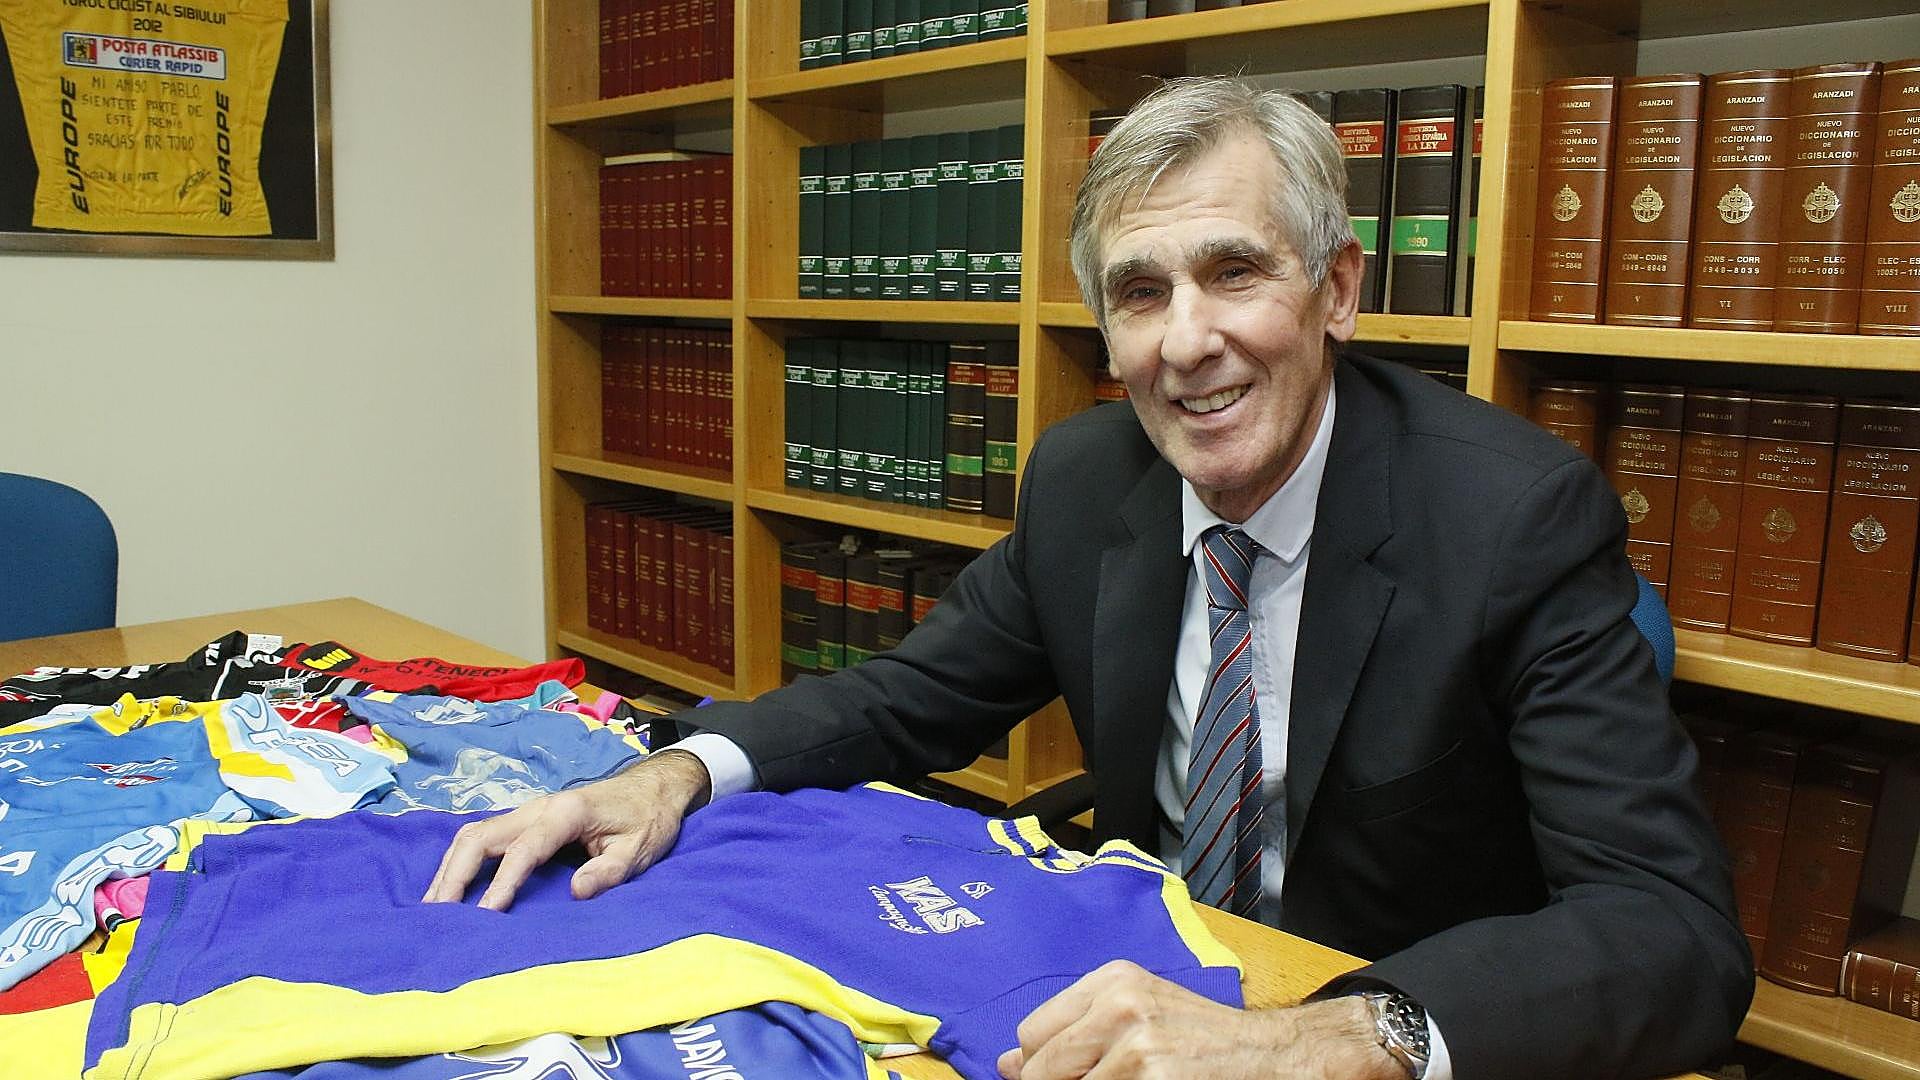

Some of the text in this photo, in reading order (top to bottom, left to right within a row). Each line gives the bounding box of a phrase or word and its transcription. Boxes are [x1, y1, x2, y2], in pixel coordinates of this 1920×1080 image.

[155, 3, 171, 16] AL
[174, 6, 226, 24] SIBIULUI
[133, 18, 162, 32] 2012
[102, 38, 219, 63] POSTA ATLASSIB
[119, 56, 203, 74] CURIER RAPID
[161, 81, 200, 99] PABLO
[1812, 90, 1854, 99] ARANZADI
[1639, 99, 1673, 108] ARANZADI
[1726, 96, 1765, 105] ARANZADI
[187, 104, 203, 117] DE
[106, 114, 132, 128] ESTE
[1817, 120, 1842, 128] NUEVO
[1714, 135, 1773, 144] DICCIONARIO
[1799, 131, 1861, 140] DICCIONARIO
[1551, 137, 1598, 145] ICCIONARIO
[1627, 136, 1681, 145] DICCIONARIO
[60, 76, 90, 215] EUROPE
[1354, 144, 1371, 152] LEY
[1407, 142, 1418, 150] LA
[216, 90, 233, 217] EUROPE
[1797, 151, 1859, 160] LEGISLACION
[1625, 155, 1680, 164] LEGISLACION
[1712, 155, 1771, 163] LEGISLACION
[1703, 255, 1725, 263] CONS
[1737, 256, 1760, 264] CORR
[1788, 256, 1810, 264] CORR
[1823, 256, 1846, 264] ELEC
[1877, 257, 1899, 265] ELEC
[1719, 300, 1732, 308] VI
[1799, 302, 1815, 310] VII
[1885, 305, 1909, 313] VIII
[1618, 441, 1666, 452] ICCIONARIO
[1616, 459, 1665, 470] EGISLACION
